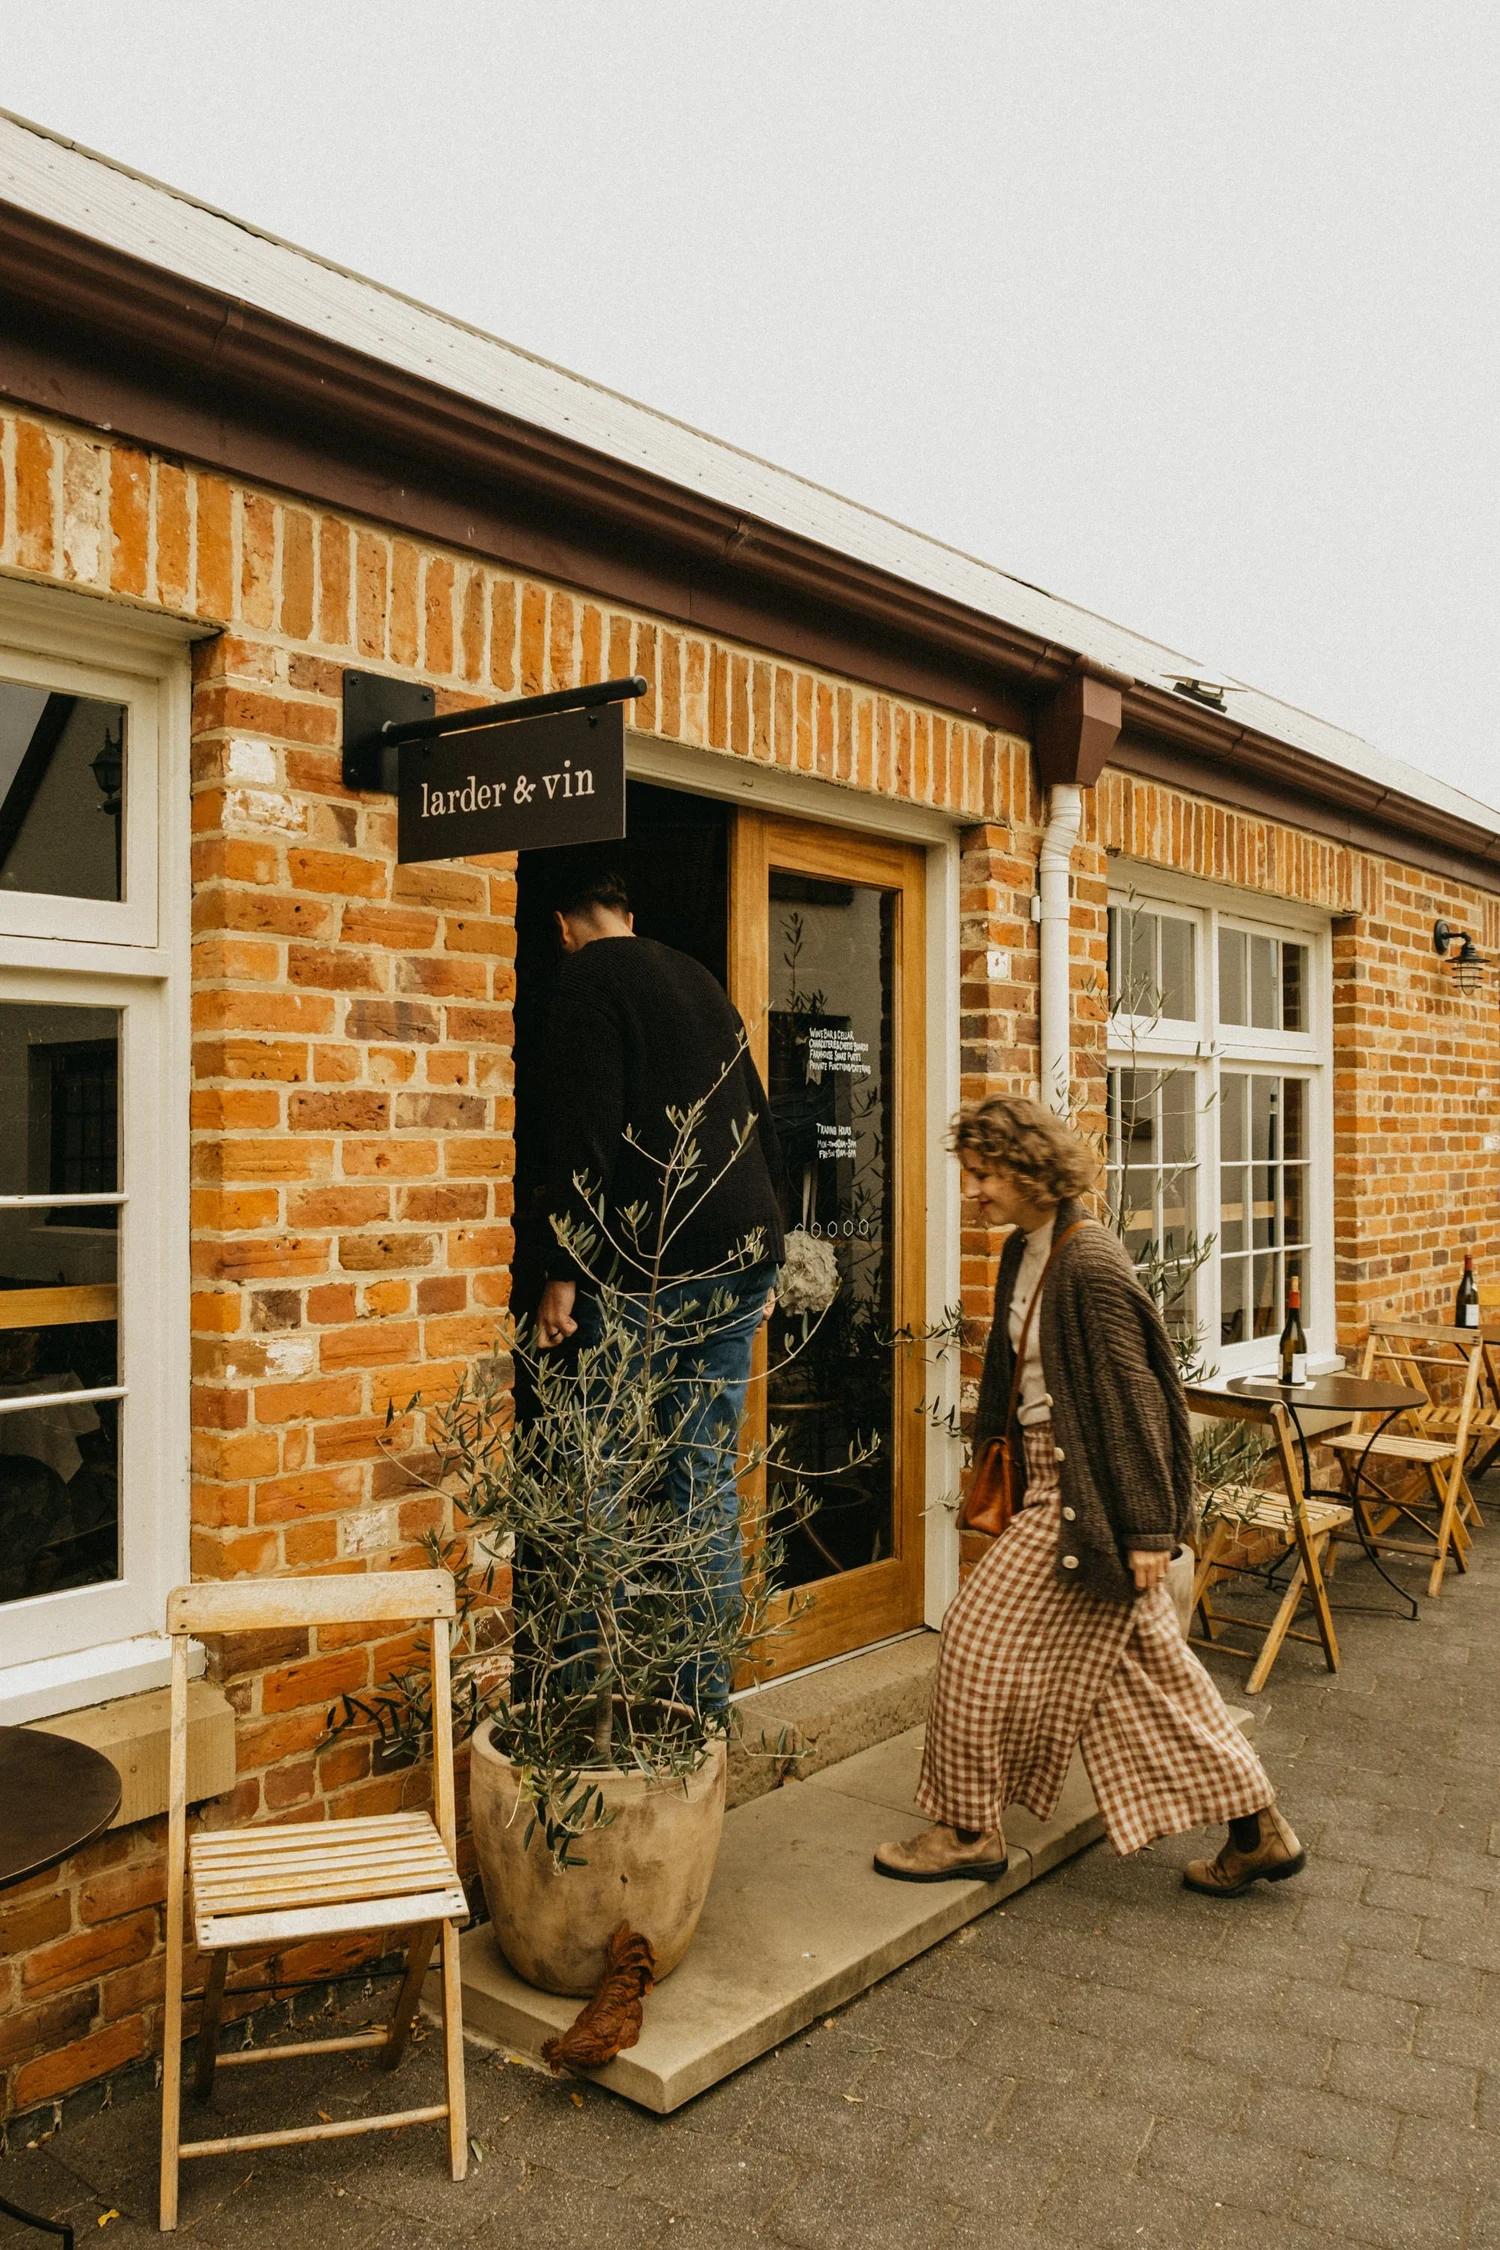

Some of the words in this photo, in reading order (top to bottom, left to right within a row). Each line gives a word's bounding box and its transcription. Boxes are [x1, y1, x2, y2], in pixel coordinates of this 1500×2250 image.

[421, 775, 506, 818] larder
[513, 775, 536, 804] &
[542, 760, 595, 800] vin
[837, 1030, 854, 1040] CELLAR
[810, 1060, 827, 1070] PRIVATE
[816, 1123, 836, 1135] TRADING
[838, 1125, 851, 1135] HOURS
